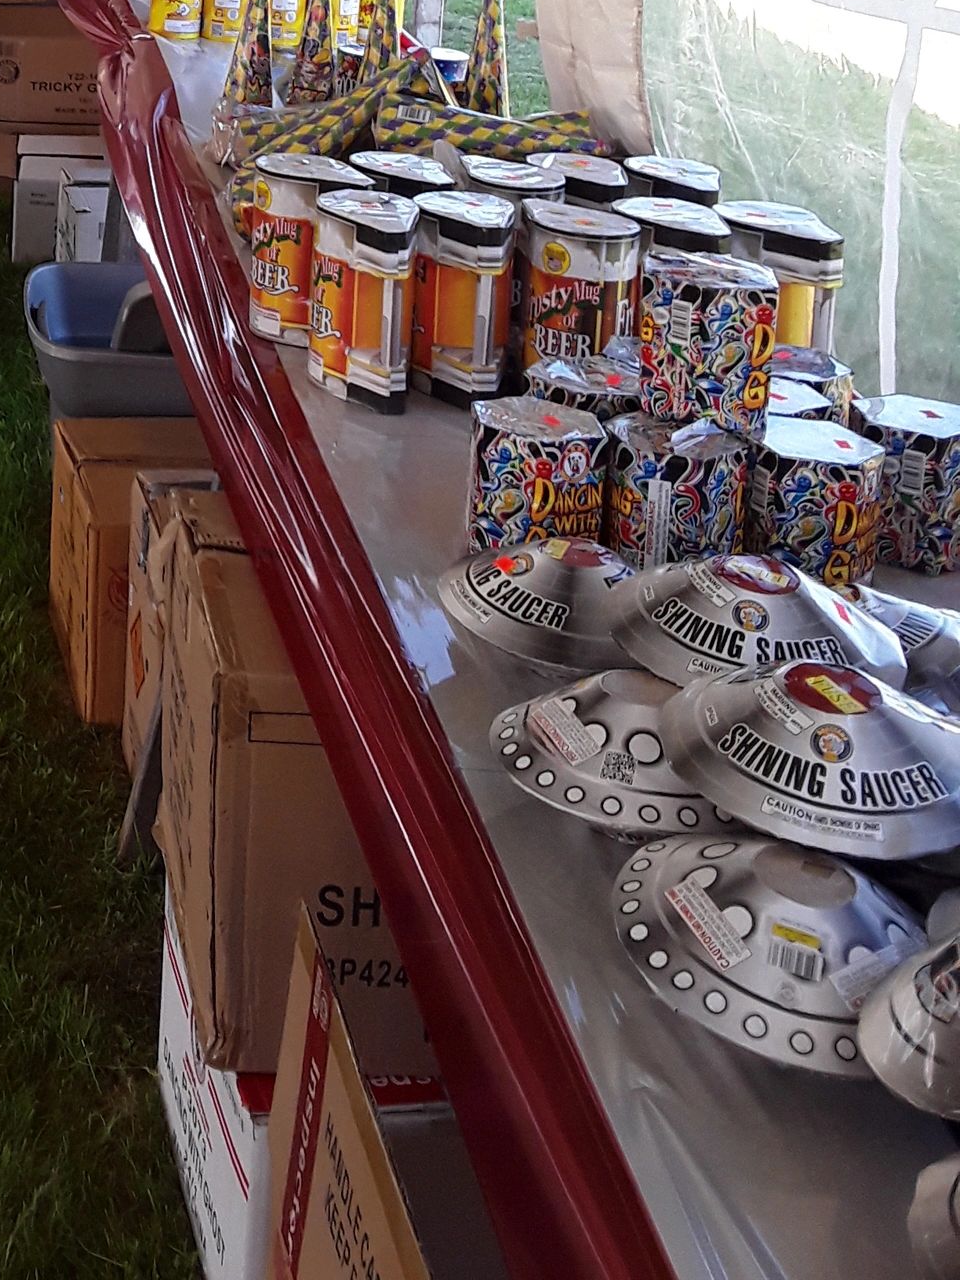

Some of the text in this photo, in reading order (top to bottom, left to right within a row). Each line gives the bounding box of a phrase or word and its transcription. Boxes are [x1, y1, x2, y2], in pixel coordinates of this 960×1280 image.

[30, 81, 98, 93] TRICKY G
[252, 218, 297, 247] sty Mug
[267, 246, 280, 261] of
[321, 257, 340, 281] Mug
[251, 257, 299, 295] BEER
[573, 280, 600, 304] Mug
[312, 304, 340, 338] ER
[563, 312, 578, 328] of
[533, 323, 591, 360] BEER
[532, 477, 603, 520] DANCIN
[554, 513, 599, 535] WITH
[486, 579, 568, 629] SAUCER
[653, 598, 846, 665] SHINING SAUCER
[720, 725, 947, 808] SHINING SAUCER
[766, 797, 812, 821] CAUTION
[317, 884, 380, 927] SH
[701, 930, 730, 968] CAUTION
[287, 1057, 320, 1257] Inspector
[325, 1111, 362, 1245] HANDLE
[202, 1181, 226, 1266] GHOST
[325, 1183, 351, 1267] KEEP
